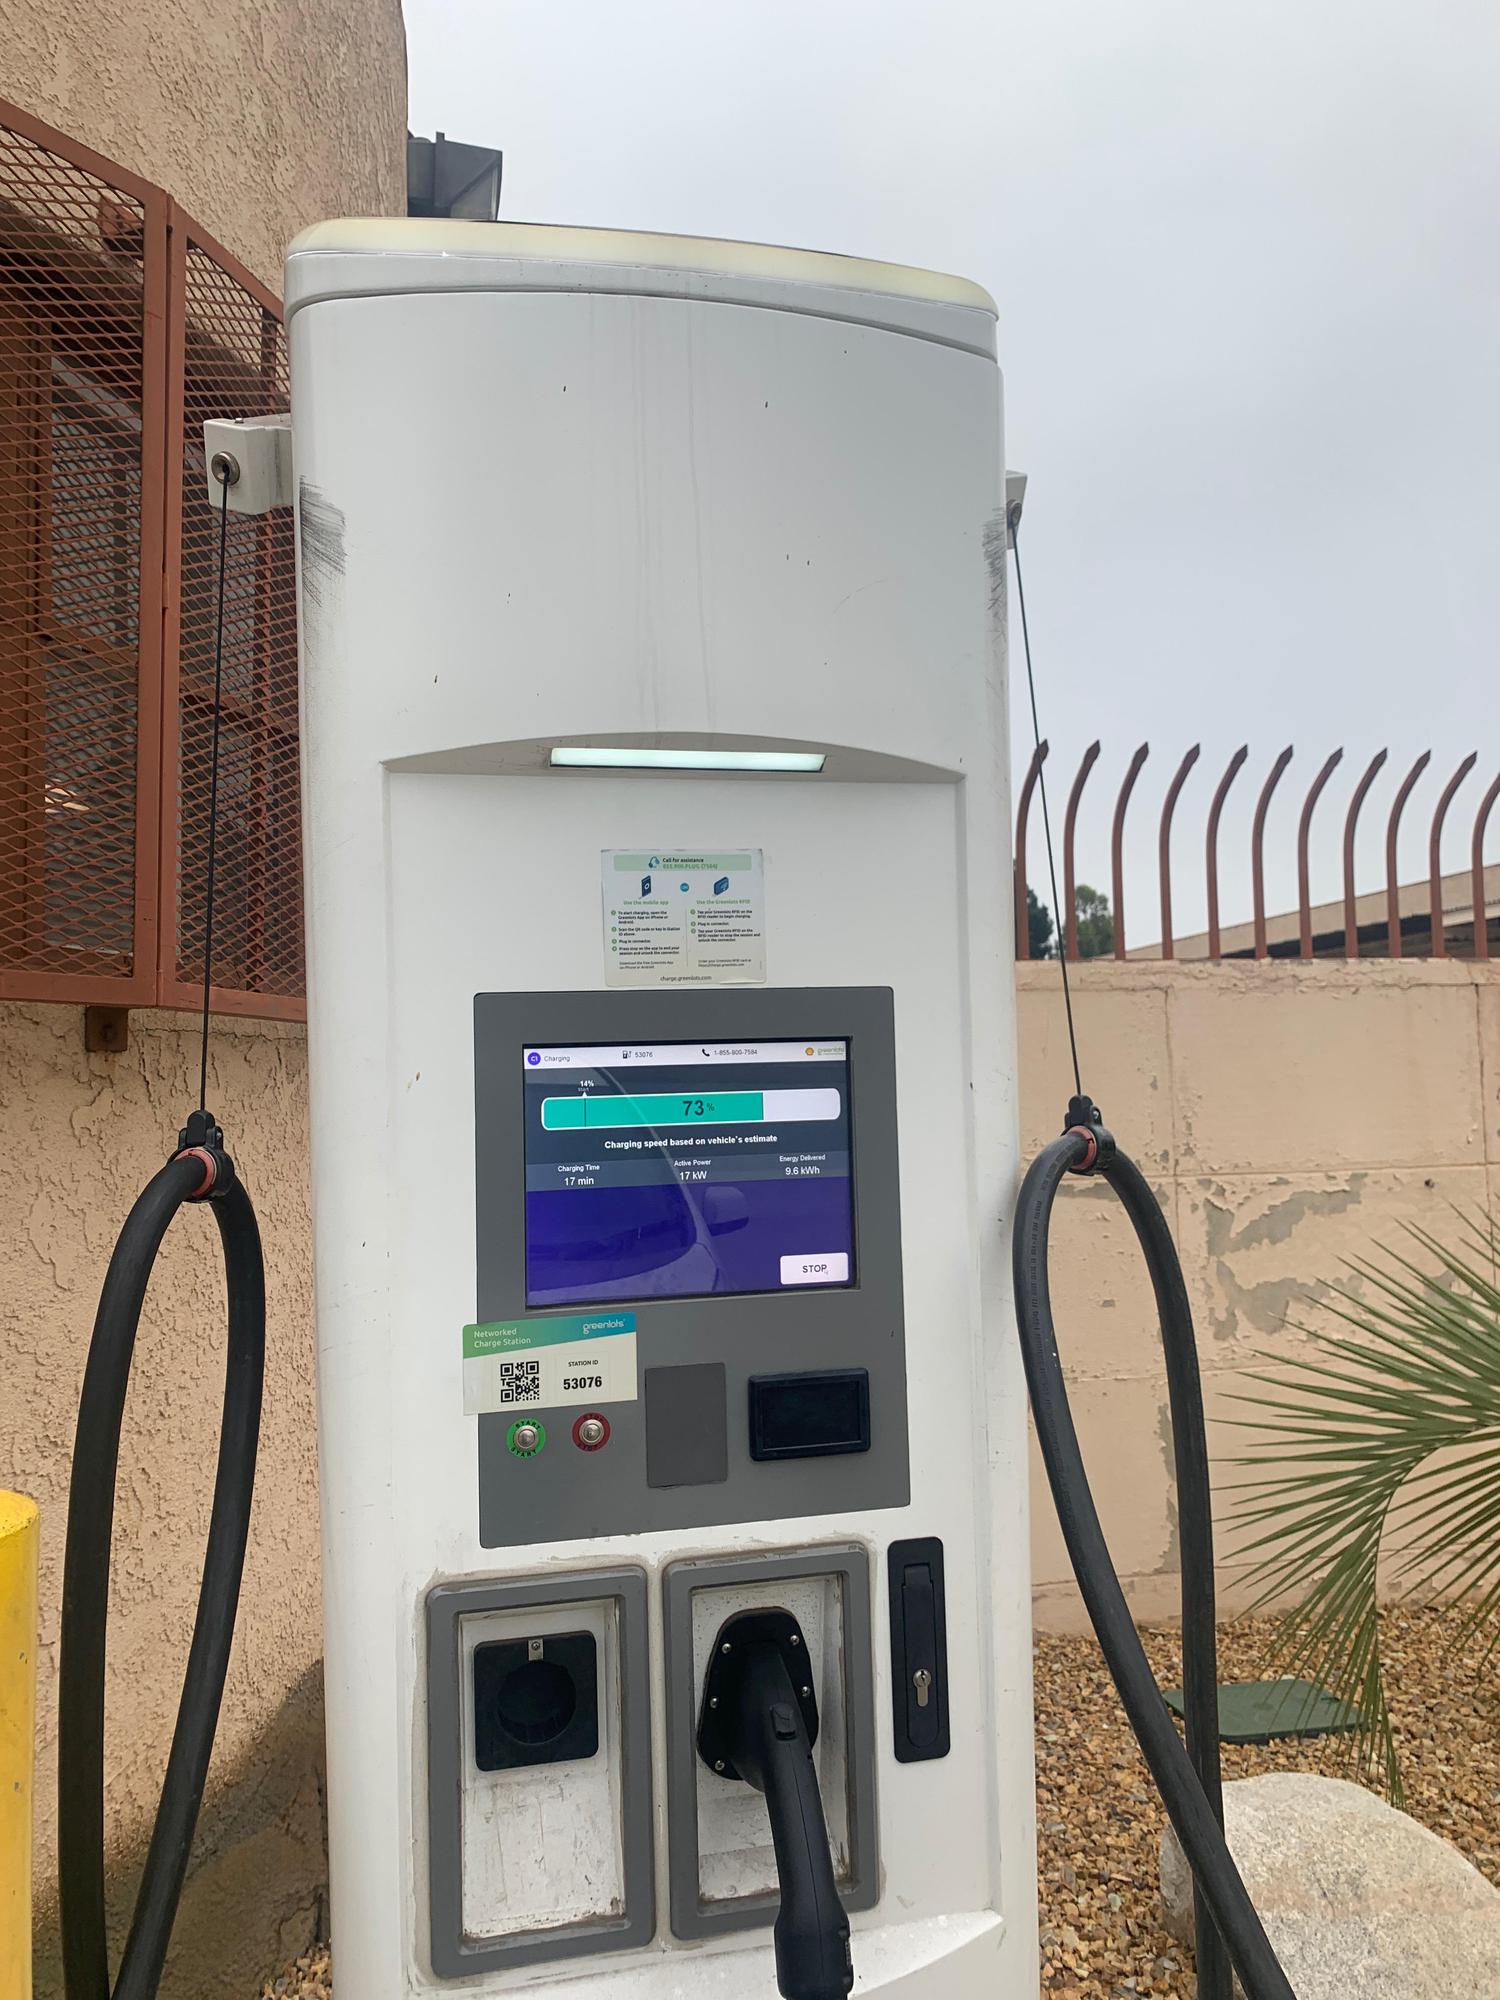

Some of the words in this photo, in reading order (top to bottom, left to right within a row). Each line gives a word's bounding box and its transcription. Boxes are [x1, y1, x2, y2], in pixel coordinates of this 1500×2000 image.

[604, 1140, 642, 1150] Charging
[644, 1139, 668, 1148] speed
[670, 1138, 693, 1146] based
[708, 1135, 743, 1144] vehicle's
[744, 1135, 777, 1143] estimate
[779, 1155, 799, 1163] Energy
[679, 1172, 691, 1180] 17
[692, 1171, 707, 1179] kW
[785, 1167, 799, 1175] 9.6
[800, 1166, 820, 1175] kWh
[564, 1177, 575, 1186] 17
[578, 1176, 594, 1185] min
[802, 1264, 827, 1273] STOP
[583, 1320, 624, 1334] greenlots
[474, 1328, 517, 1338] Networked
[474, 1339, 501, 1349] Charge
[504, 1337, 531, 1346] Station
[563, 1376, 602, 1390] 53076
